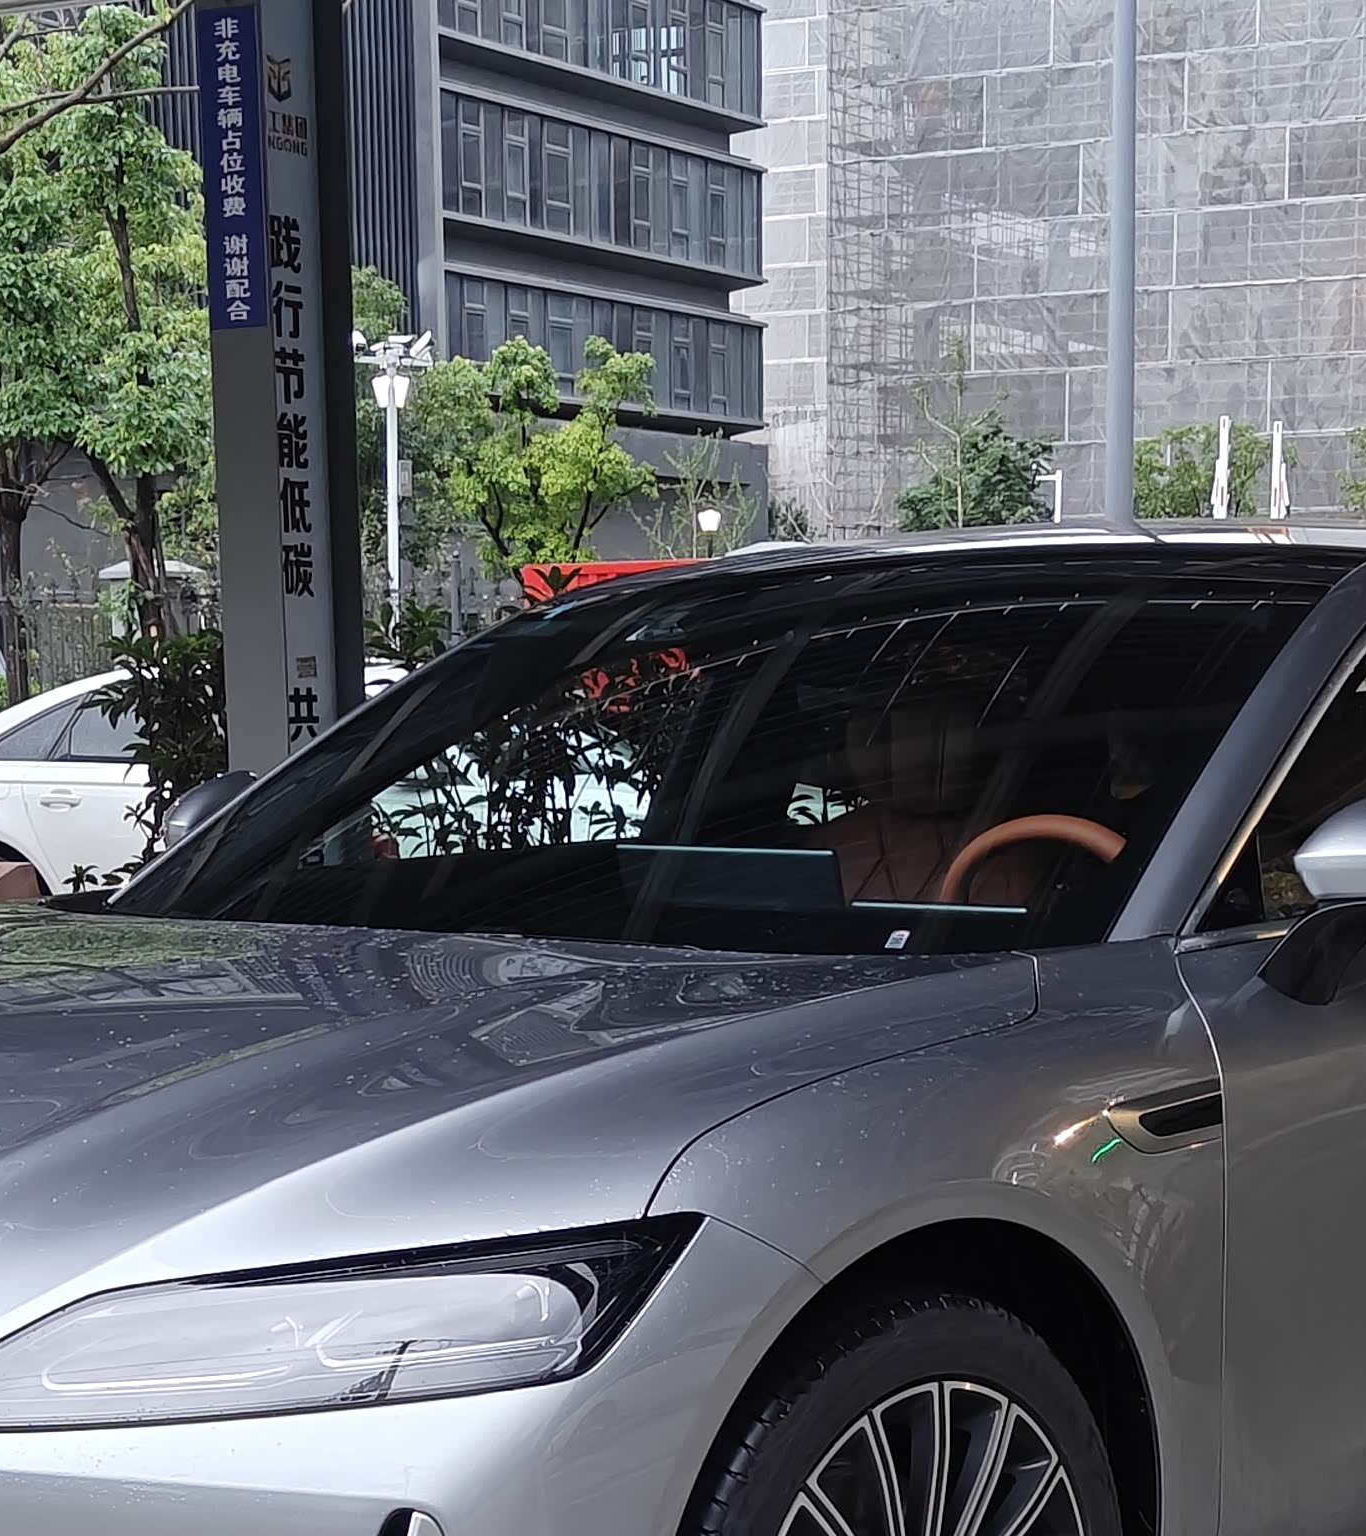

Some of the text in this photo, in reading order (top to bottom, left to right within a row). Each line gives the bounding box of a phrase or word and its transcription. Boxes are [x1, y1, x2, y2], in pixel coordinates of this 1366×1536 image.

[214, 17, 251, 321] 非充电车辆占位收费 谢谢配合
[269, 214, 315, 598] 践行节能低碳
[288, 687, 319, 742] 共
